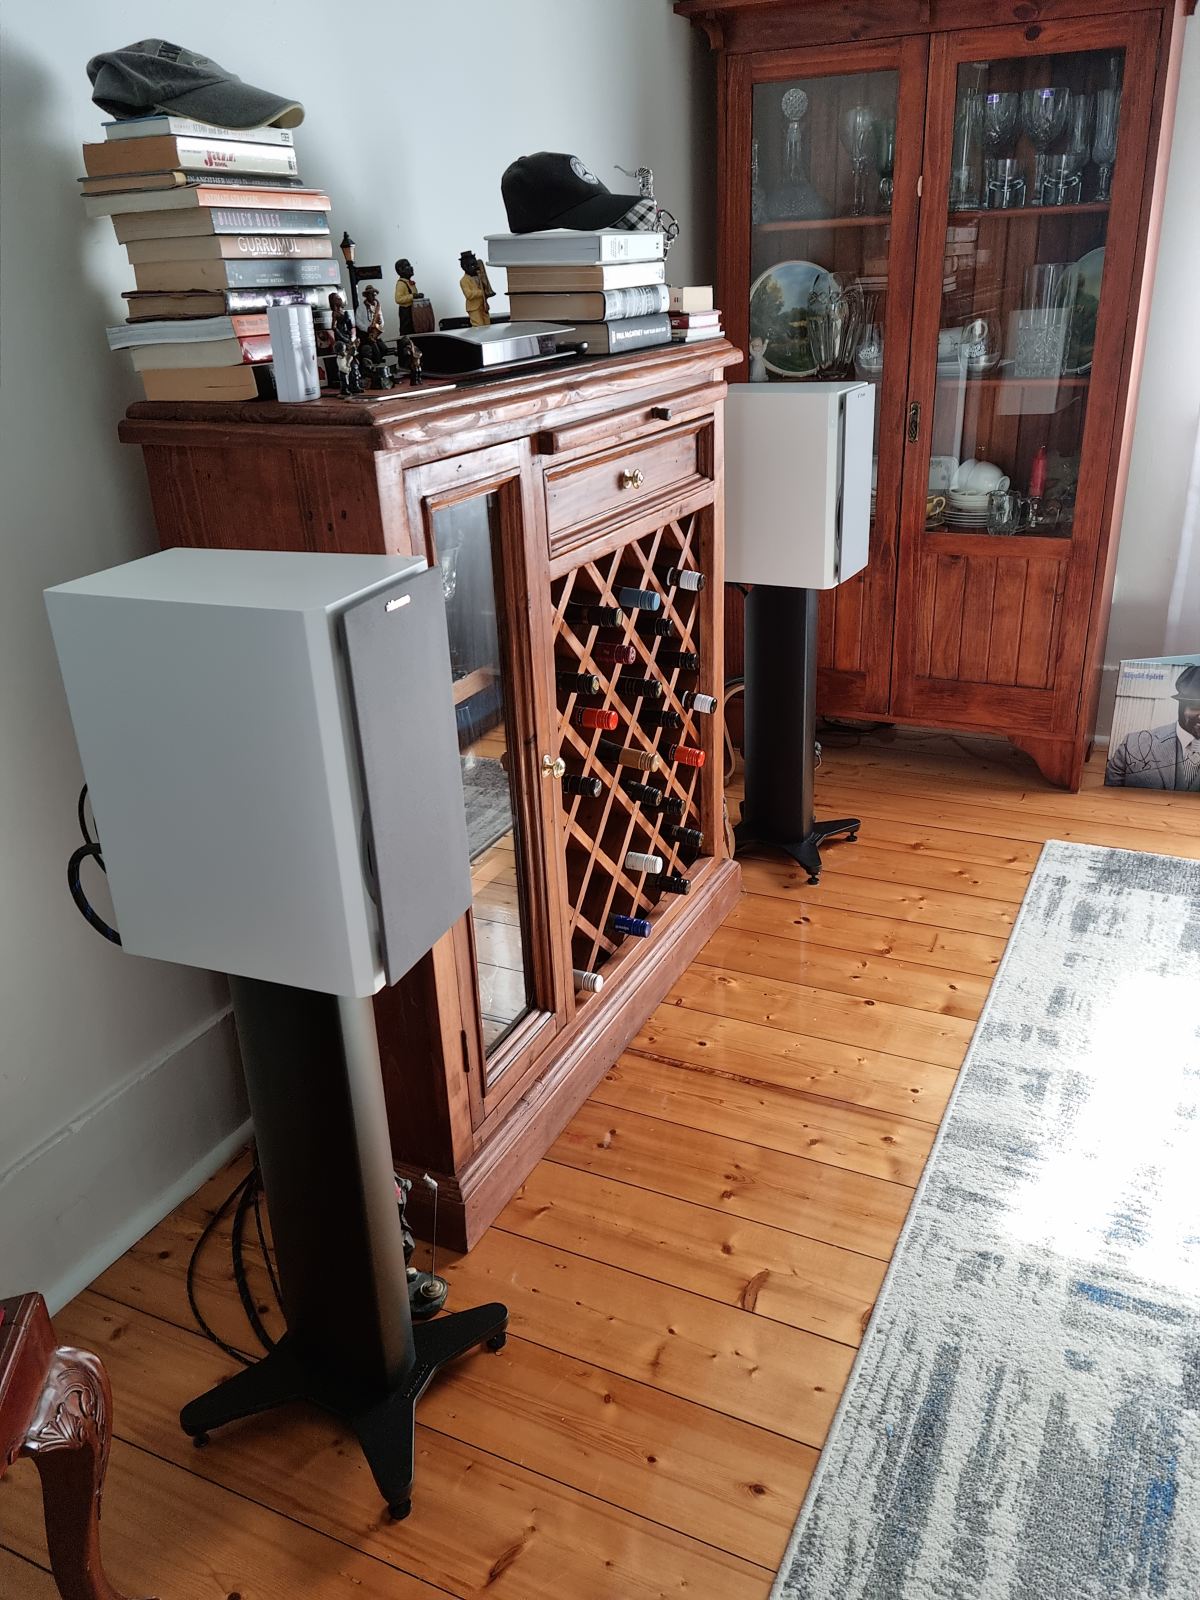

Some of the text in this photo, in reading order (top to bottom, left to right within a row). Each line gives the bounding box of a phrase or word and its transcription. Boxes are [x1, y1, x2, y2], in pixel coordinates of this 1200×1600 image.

[217, 211, 253, 227] BILLIE'S
[254, 212, 280, 228] BLUES
[237, 236, 301, 253] GURRUMUL
